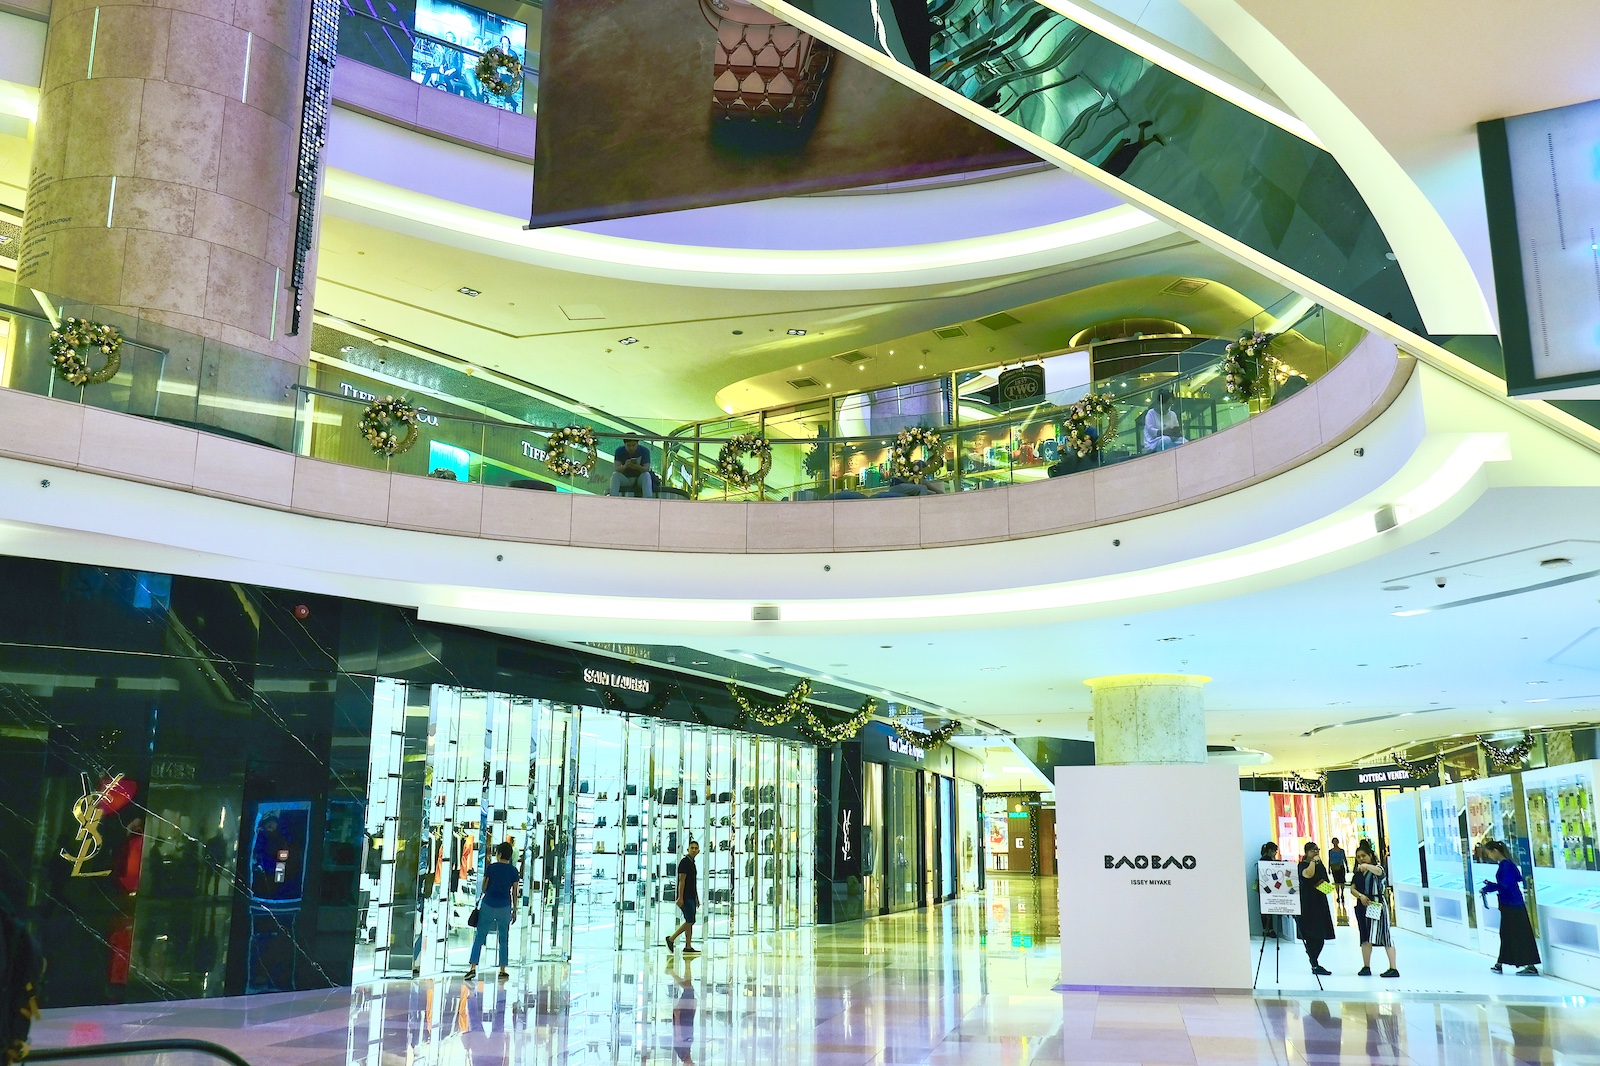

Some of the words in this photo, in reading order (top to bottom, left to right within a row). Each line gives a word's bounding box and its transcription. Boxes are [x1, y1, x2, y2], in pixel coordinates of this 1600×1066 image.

[1006, 382, 1037, 398] TWG
[521, 440, 551, 463] TIFFA
[1358, 772, 1388, 784] BOTTEGA
[1386, 769, 1410, 781] VENETA
[1282, 780, 1321, 793] BVLG
